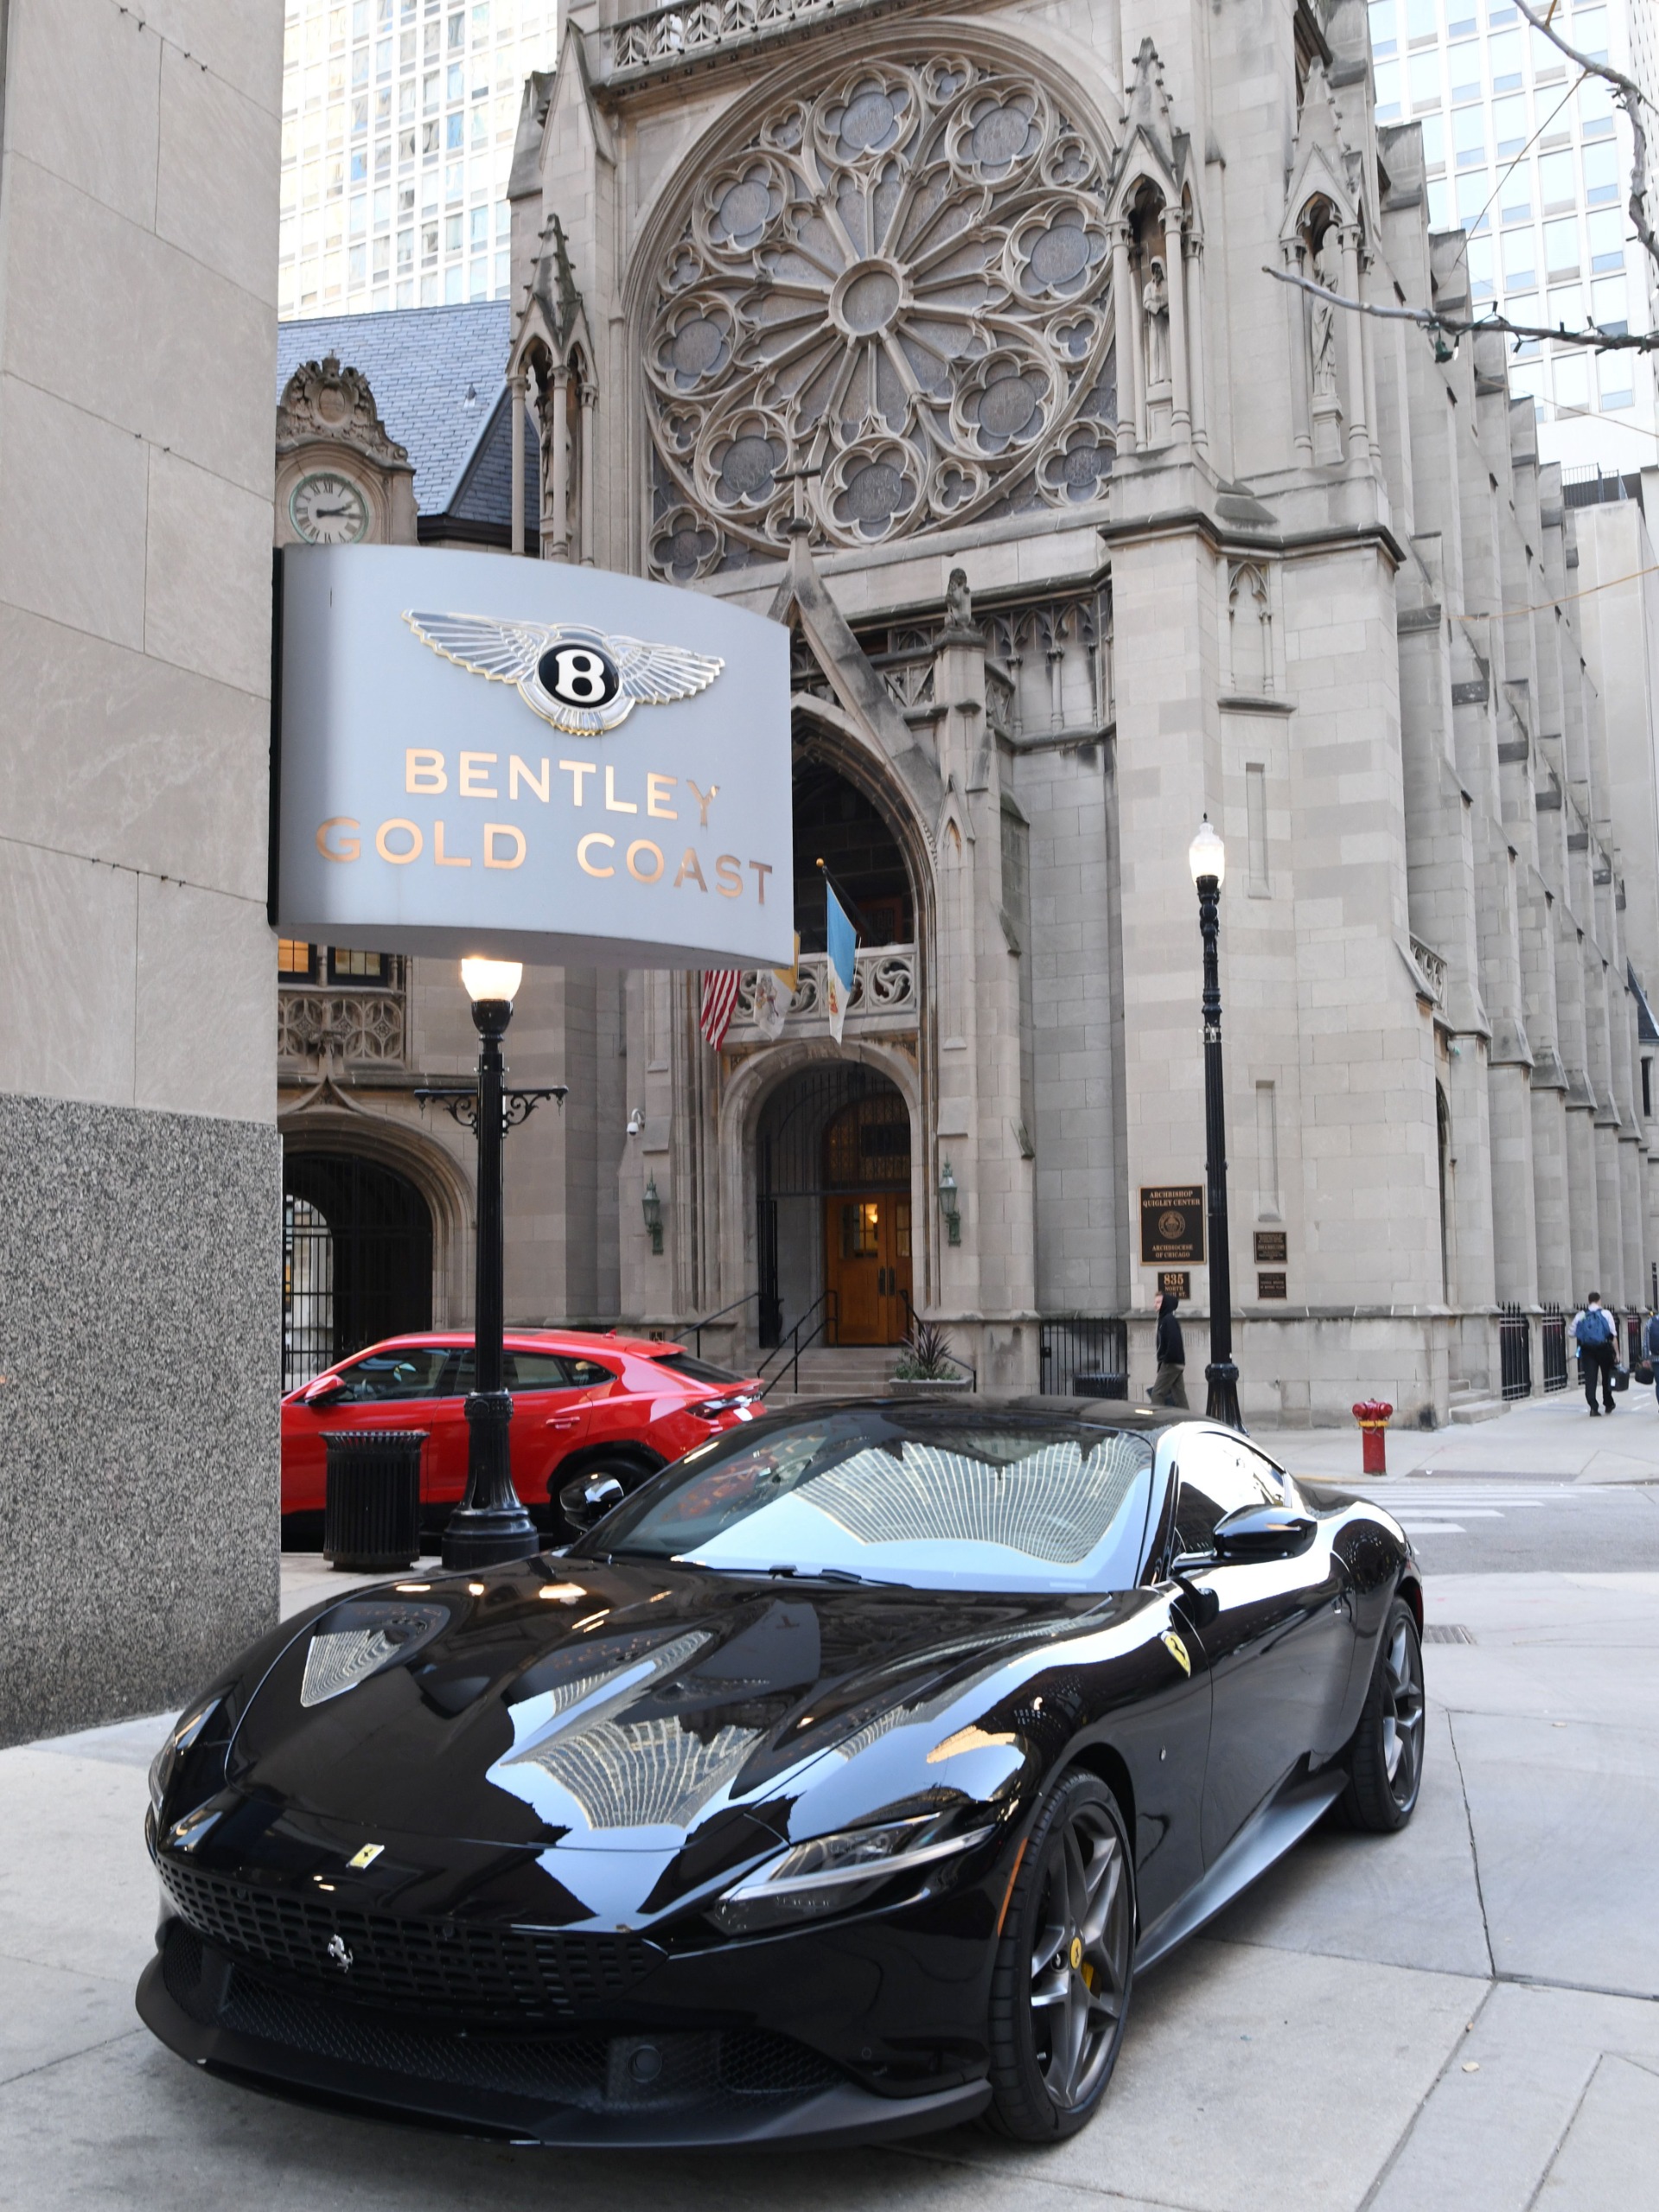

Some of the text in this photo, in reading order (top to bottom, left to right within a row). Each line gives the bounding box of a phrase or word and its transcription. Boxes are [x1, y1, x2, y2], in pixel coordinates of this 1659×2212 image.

[554, 650, 605, 703] B
[405, 747, 720, 826] BENTLEY
[316, 816, 773, 904] GOLD COAST
[1143, 1198, 1200, 1208] QUIGLEY CENTER
[1150, 1190, 1193, 1199] ARCHBISHOP
[1164, 1273, 1184, 1285] 835
